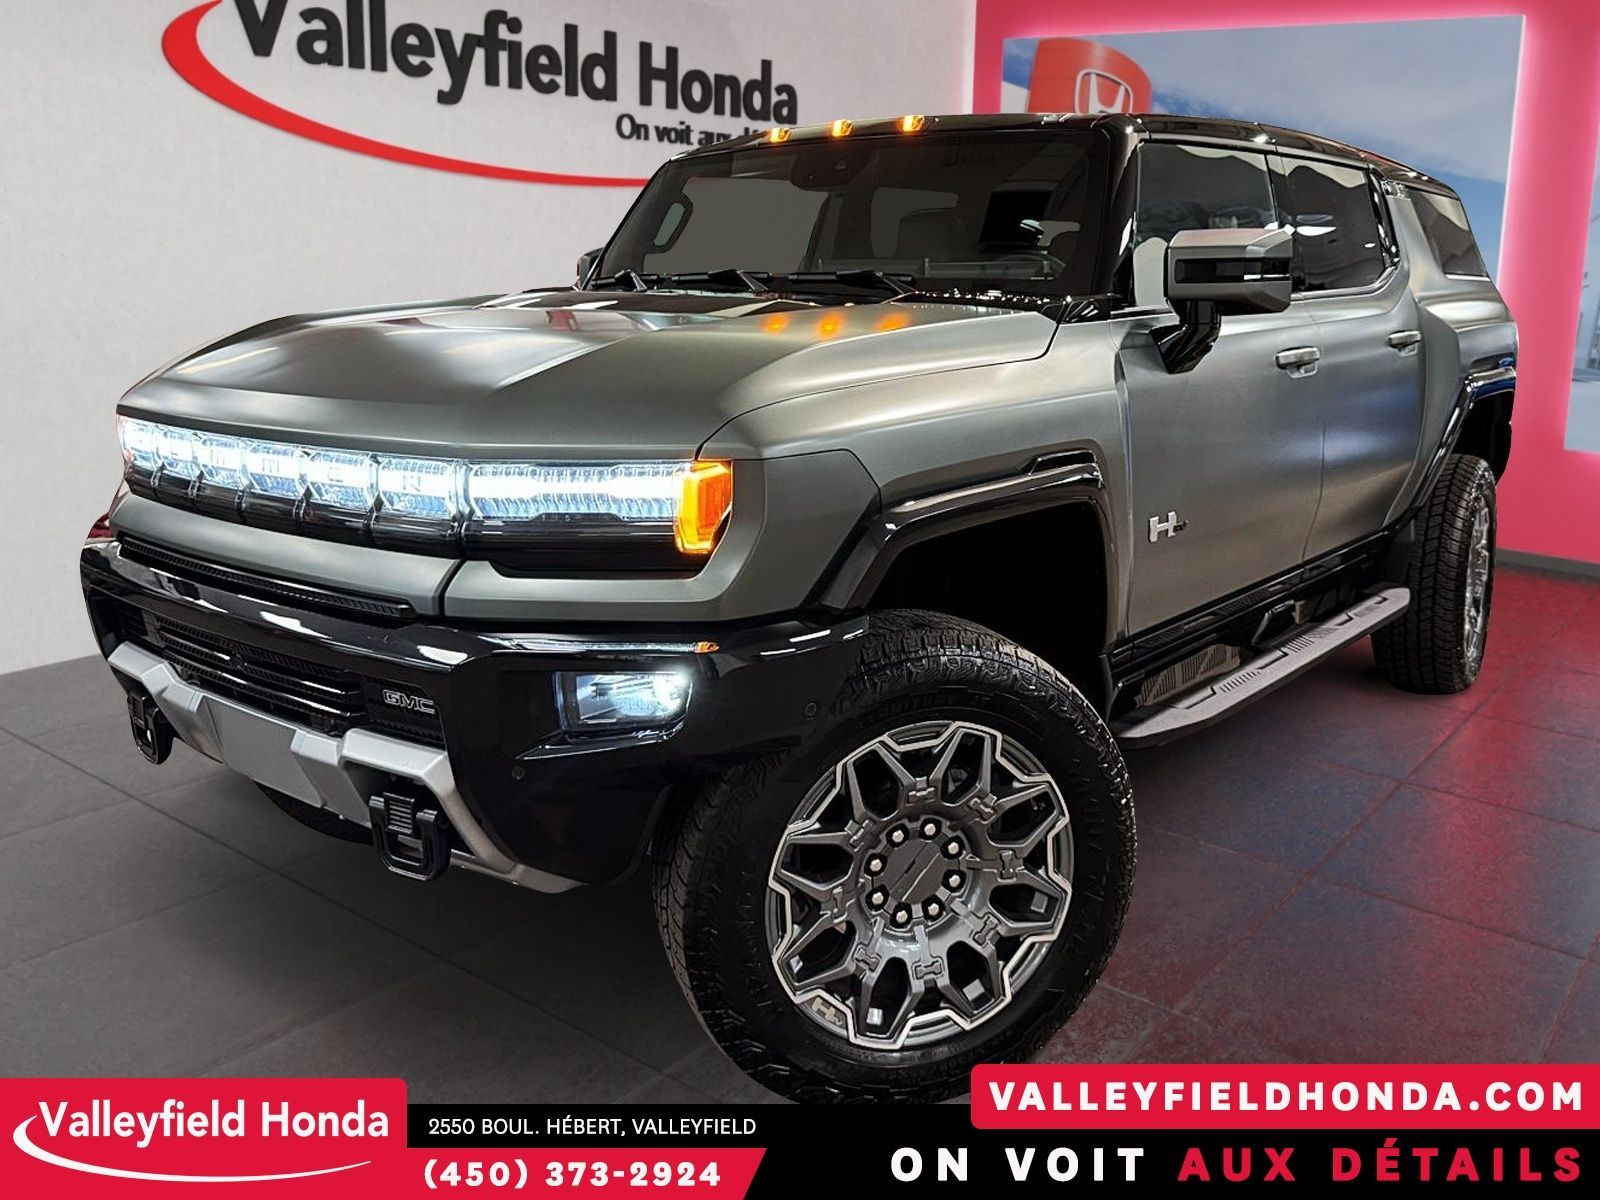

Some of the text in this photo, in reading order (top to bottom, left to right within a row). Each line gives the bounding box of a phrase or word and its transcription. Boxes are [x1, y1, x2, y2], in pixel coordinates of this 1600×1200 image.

[234, 0, 798, 125] Valleyfield Honda
[615, 113, 650, 141] On
[654, 120, 694, 146] voit
[382, 689, 435, 714] GMC
